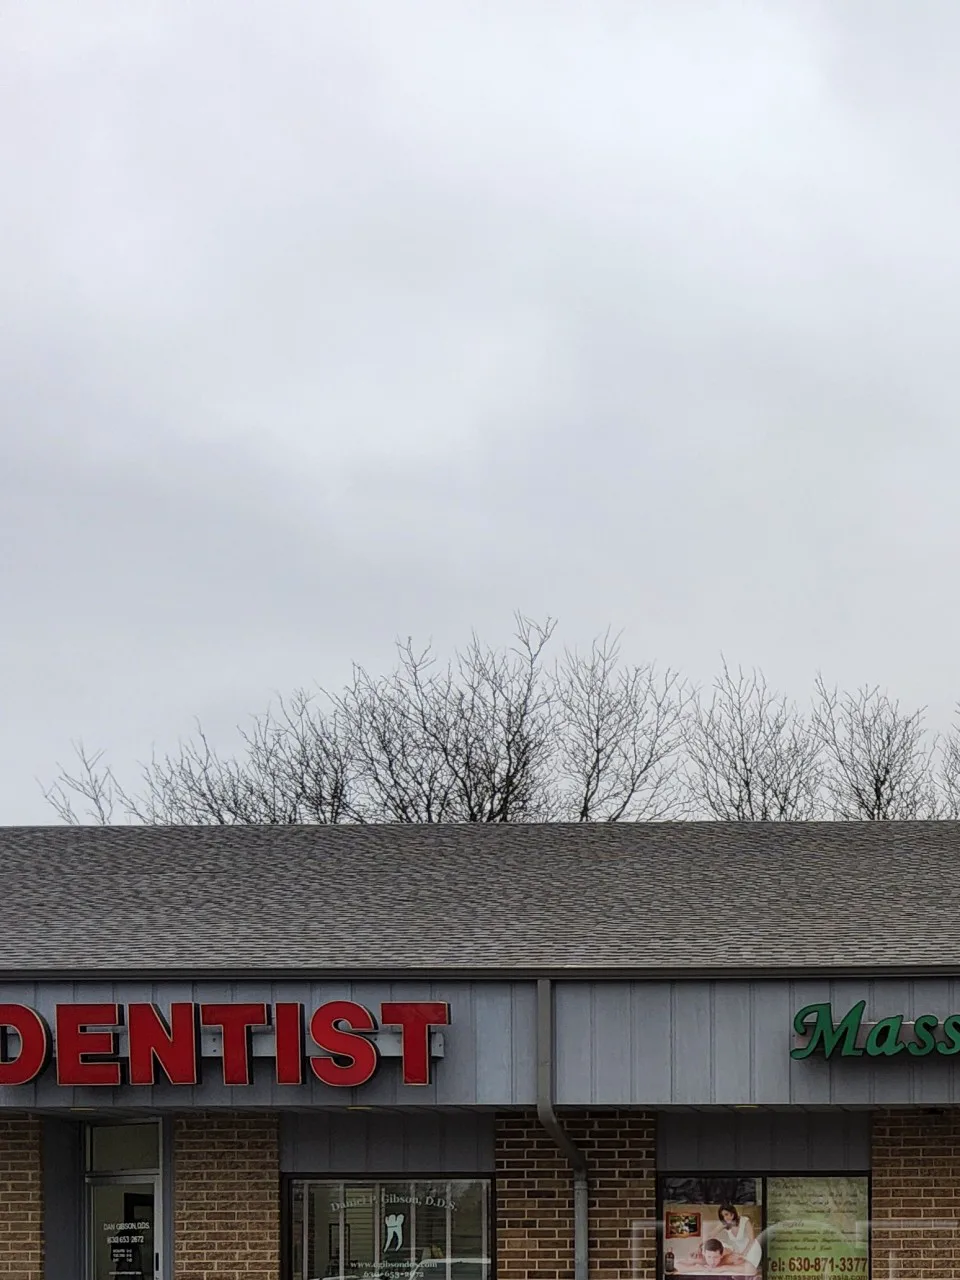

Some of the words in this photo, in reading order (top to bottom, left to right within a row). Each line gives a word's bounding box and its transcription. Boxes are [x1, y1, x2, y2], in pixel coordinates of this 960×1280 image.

[0, 1001, 450, 1087] DENTIST
[330, 1195, 370, 1212] Daniel
[381, 1194, 423, 1206] Gibson,
[788, 1257, 867, 1273] 630-871-3377
